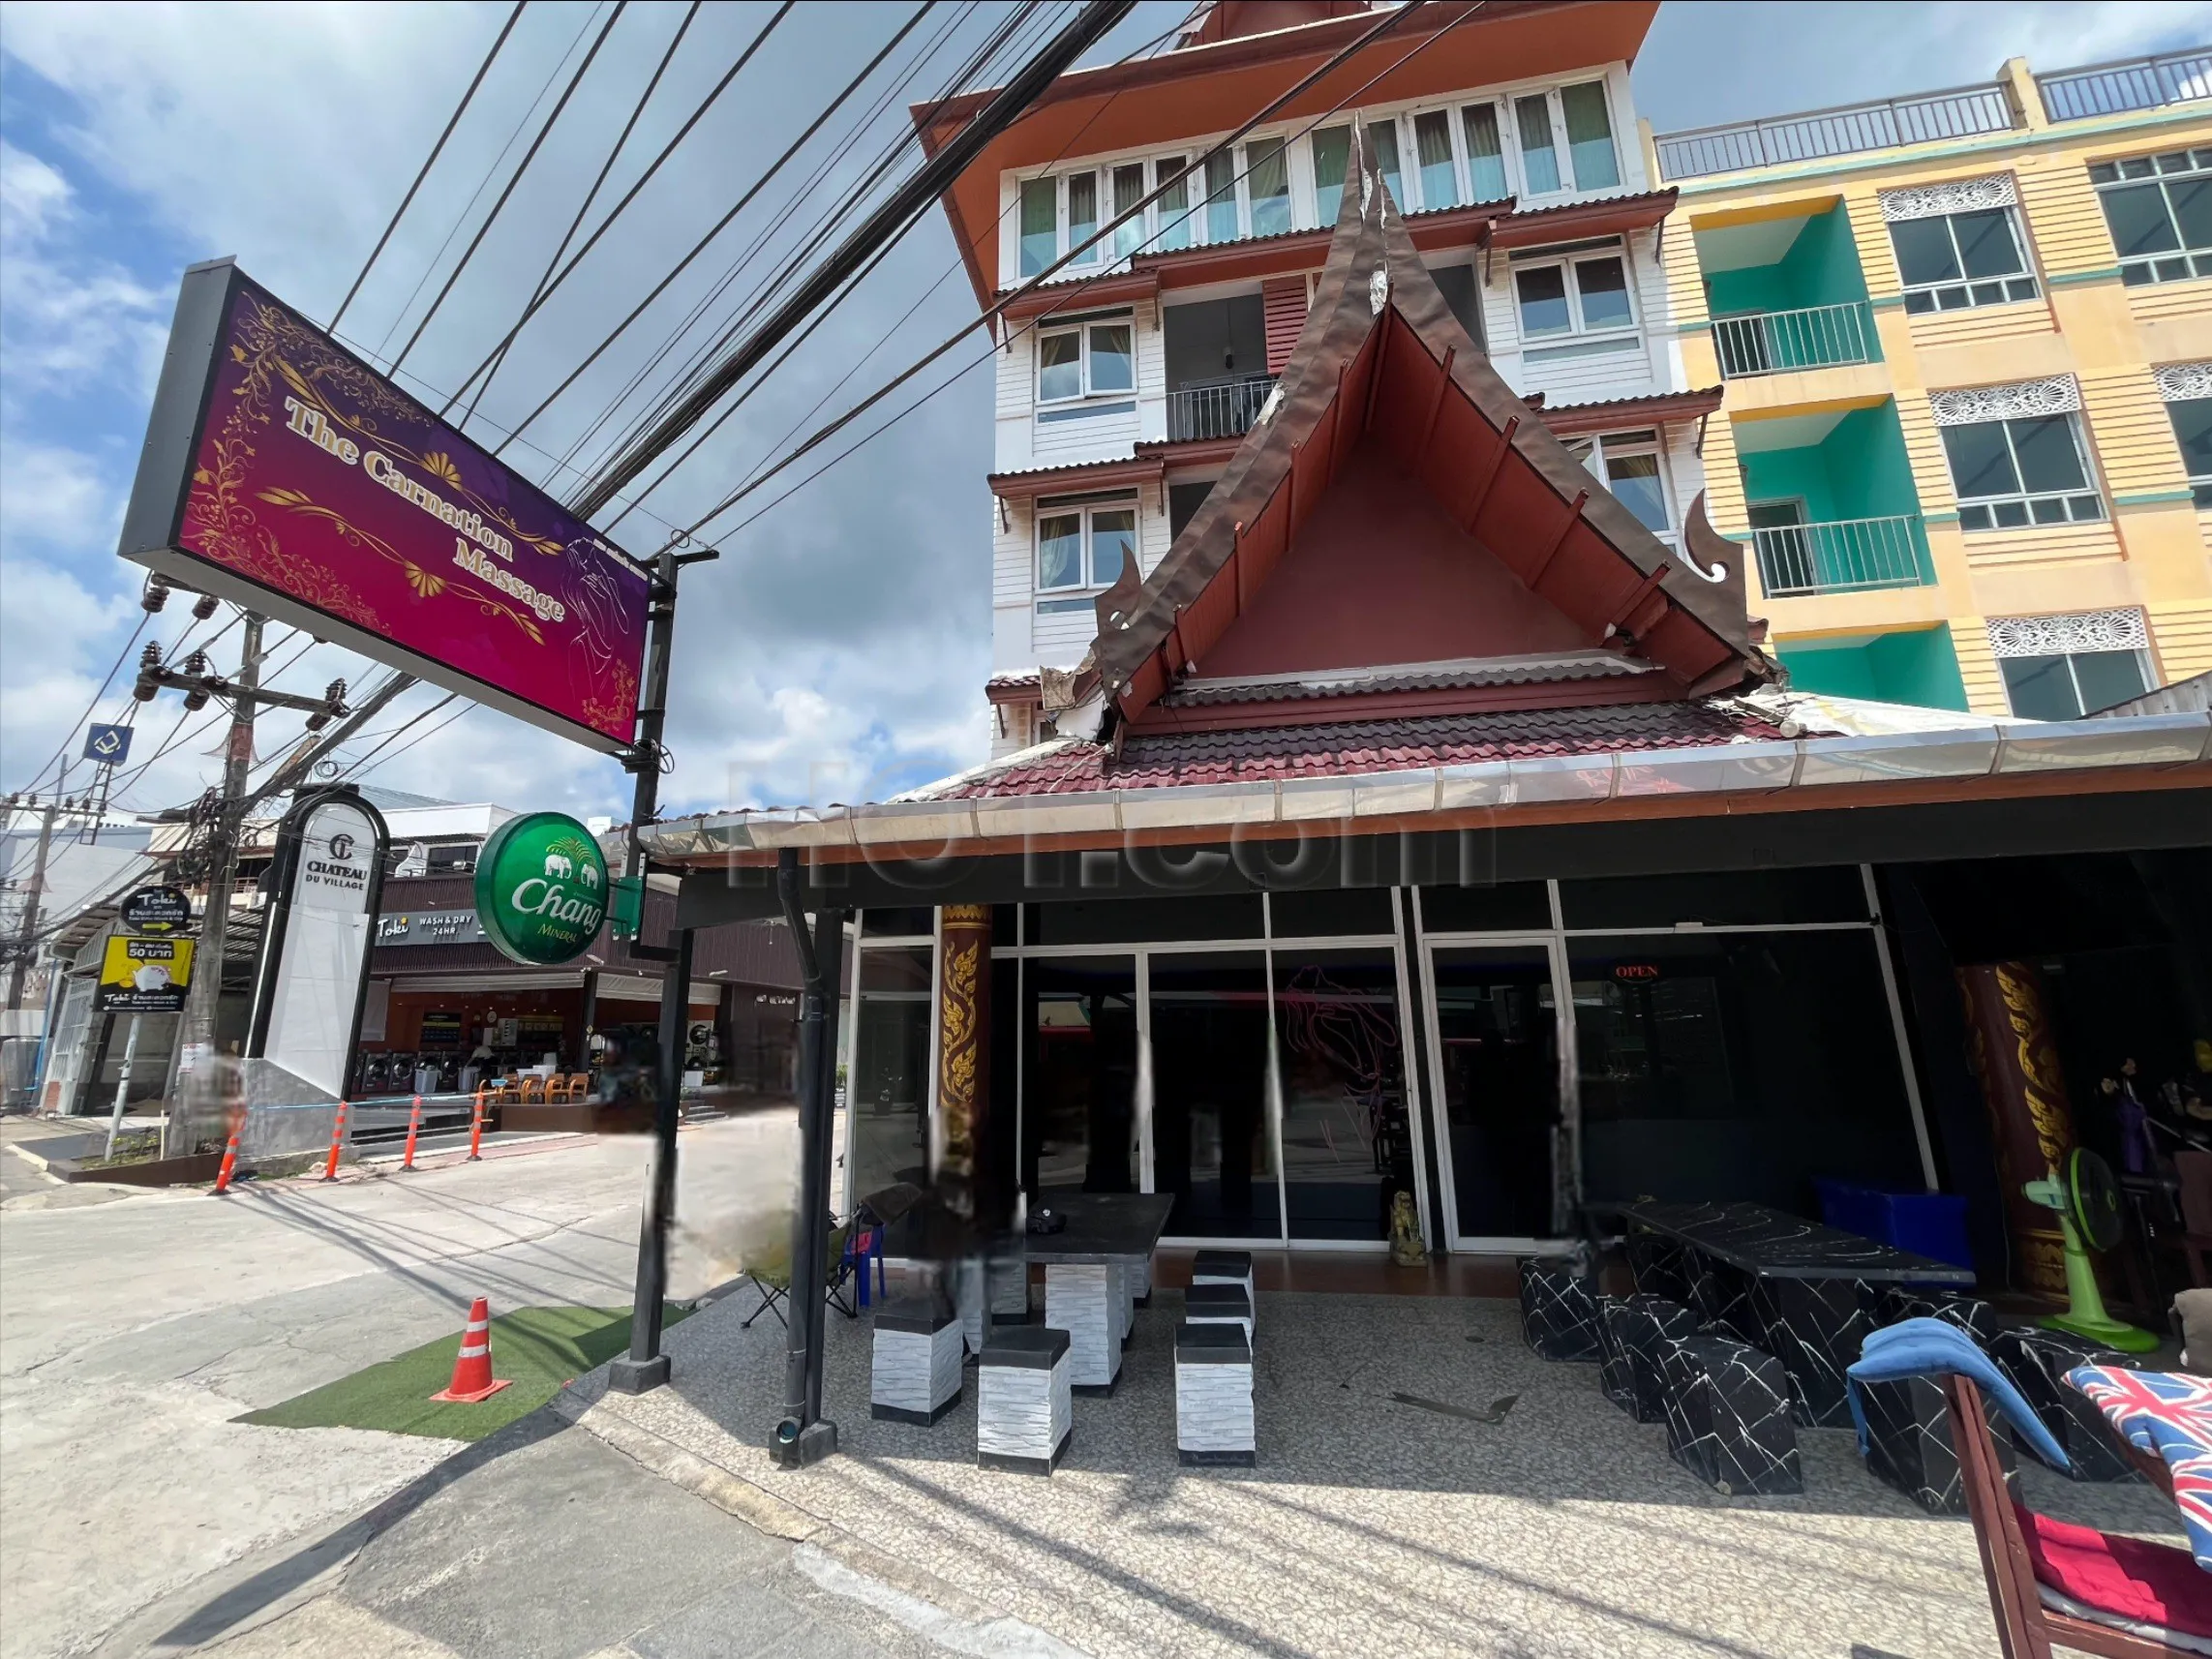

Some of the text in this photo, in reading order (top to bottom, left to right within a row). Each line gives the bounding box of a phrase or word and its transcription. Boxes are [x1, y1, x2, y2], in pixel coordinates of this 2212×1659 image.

[286, 396, 359, 465] The
[365, 450, 514, 562] Carnation
[453, 537, 565, 624] Massage
[307, 860, 367, 880] CHATEAU
[324, 877, 364, 890] VILLAGE
[136, 892, 177, 906] Toki
[511, 878, 602, 935] Chang
[378, 916, 409, 938] Toki
[419, 917, 443, 925] WASH
[453, 915, 472, 924] DRY
[129, 948, 145, 956] 50
[1616, 965, 1658, 978] OPEN
